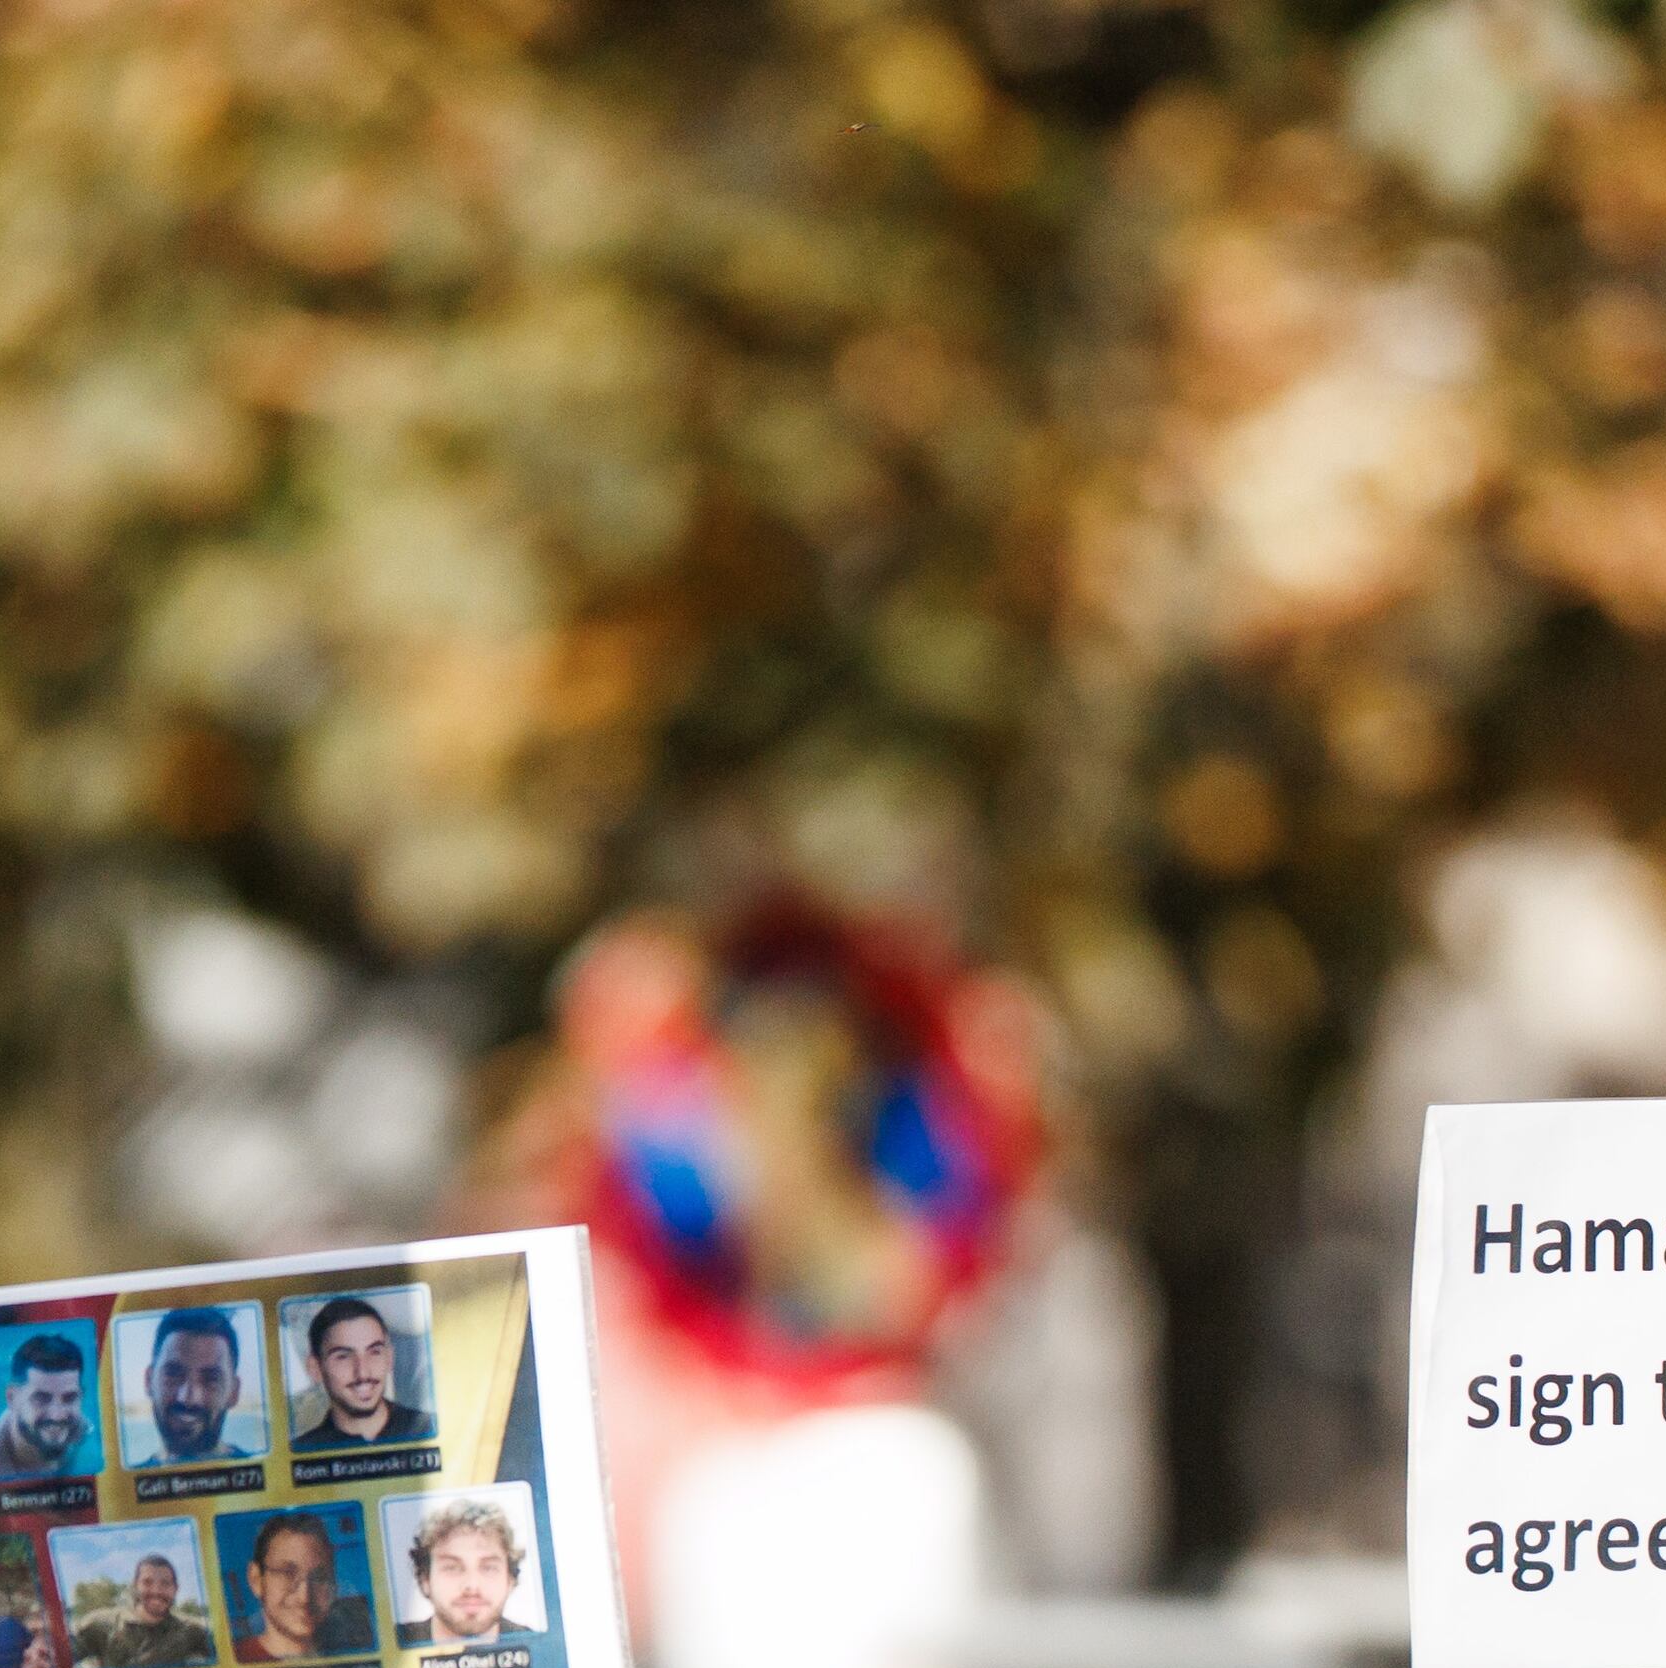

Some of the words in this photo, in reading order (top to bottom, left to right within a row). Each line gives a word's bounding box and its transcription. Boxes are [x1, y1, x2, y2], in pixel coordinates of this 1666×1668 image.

[1465, 1353, 1626, 1447] sign
[293, 1463, 330, 1482] Rom
[409, 1450, 442, 1474] (21)
[1, 1489, 58, 1509] Berman
[60, 1485, 92, 1506] (27)
[137, 1476, 167, 1499] Gali
[170, 1473, 230, 1495] Berman
[231, 1468, 264, 1492] (27)
[497, 1649, 531, 1668] (24)
